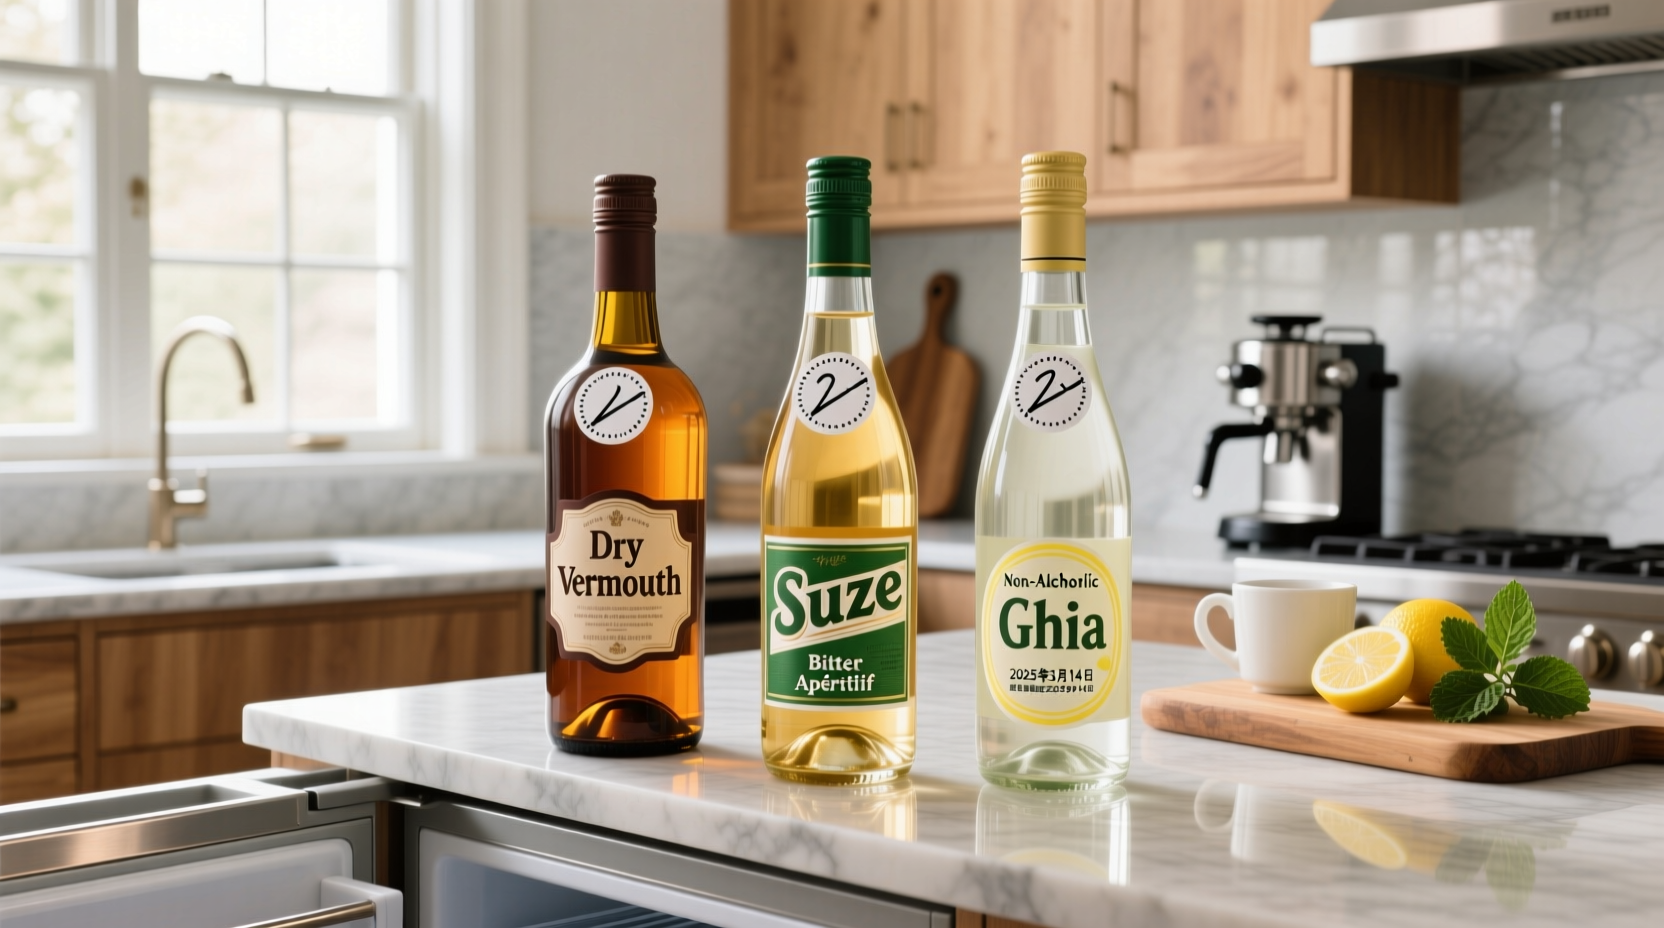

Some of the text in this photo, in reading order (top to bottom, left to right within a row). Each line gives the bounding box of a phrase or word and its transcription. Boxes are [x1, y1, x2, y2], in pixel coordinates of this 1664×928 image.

[589, 530, 645, 569] Dry
[557, 565, 682, 597] Vermouth
[774, 570, 902, 636] Suze
[998, 597, 1107, 650] Ghia
[808, 653, 863, 672] Bitter
